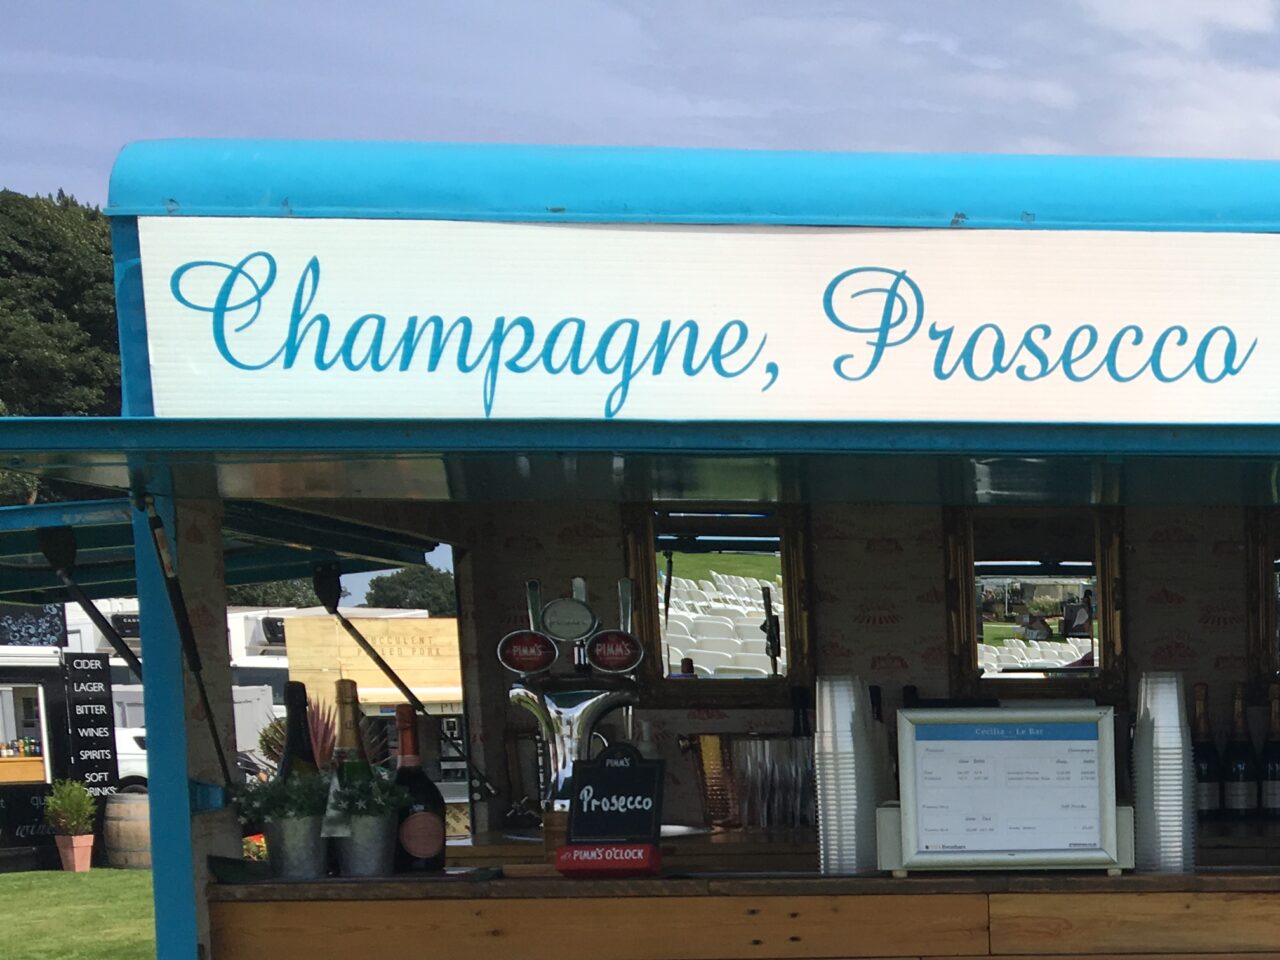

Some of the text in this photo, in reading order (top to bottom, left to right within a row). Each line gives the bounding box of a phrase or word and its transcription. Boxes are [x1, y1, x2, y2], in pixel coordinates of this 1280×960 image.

[170, 251, 779, 419] Champagne,
[822, 266, 1258, 384] Prosecco
[366, 636, 433, 645] UCCULENT
[357, 647, 440, 656] PLED PORK
[73, 659, 102, 670] CIDER
[73, 682, 105, 693] LAGER
[75, 705, 107, 715] BITTER
[78, 727, 109, 737] WINES
[975, 728, 1005, 736] Cecilia
[79, 750, 111, 760] SPIRITS
[84, 772, 110, 783] SOFT
[580, 785, 652, 813] Prosecco
[573, 848, 605, 860] PIMM'S
[605, 847, 644, 860] O'CLOCK
